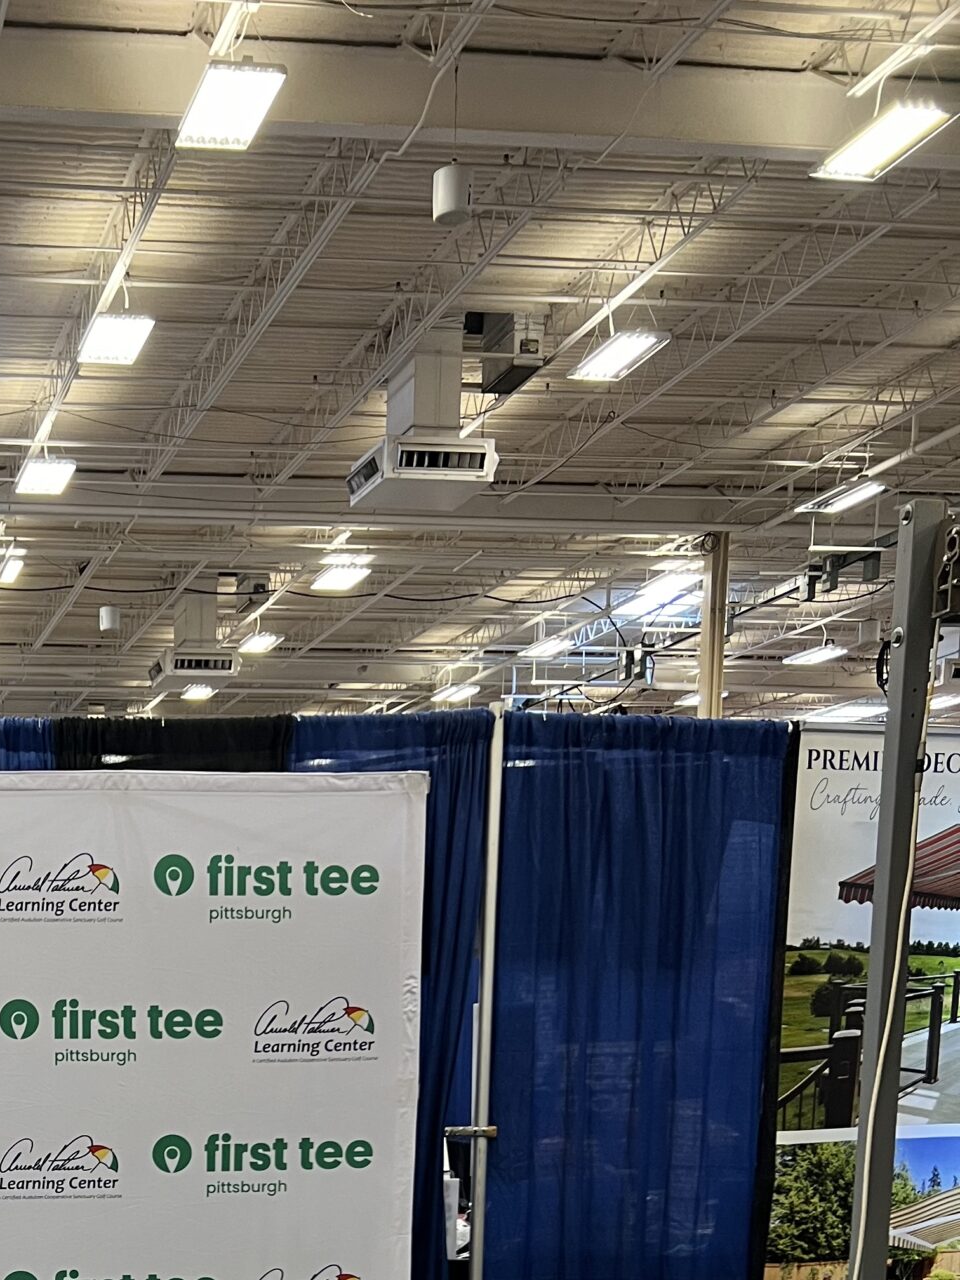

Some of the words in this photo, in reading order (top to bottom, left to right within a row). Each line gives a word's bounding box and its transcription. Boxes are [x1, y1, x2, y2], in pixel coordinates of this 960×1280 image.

[807, 749, 882, 773] PREMI
[919, 785, 952, 806] ade
[207, 854, 292, 896] first
[303, 861, 379, 896] tee
[69, 898, 120, 912] Center
[209, 906, 291, 923] pittsburgh
[52, 999, 136, 1039] first
[147, 1005, 223, 1039] tee
[254, 1039, 321, 1056] Learning
[324, 1039, 375, 1052] Center
[55, 1049, 136, 1066] pittsburgh
[204, 1133, 288, 1172] first
[298, 1137, 373, 1170] tee
[0, 1176, 66, 1193] Learning
[69, 1177, 119, 1189] Center
[206, 1180, 287, 1197] pittsburgh
